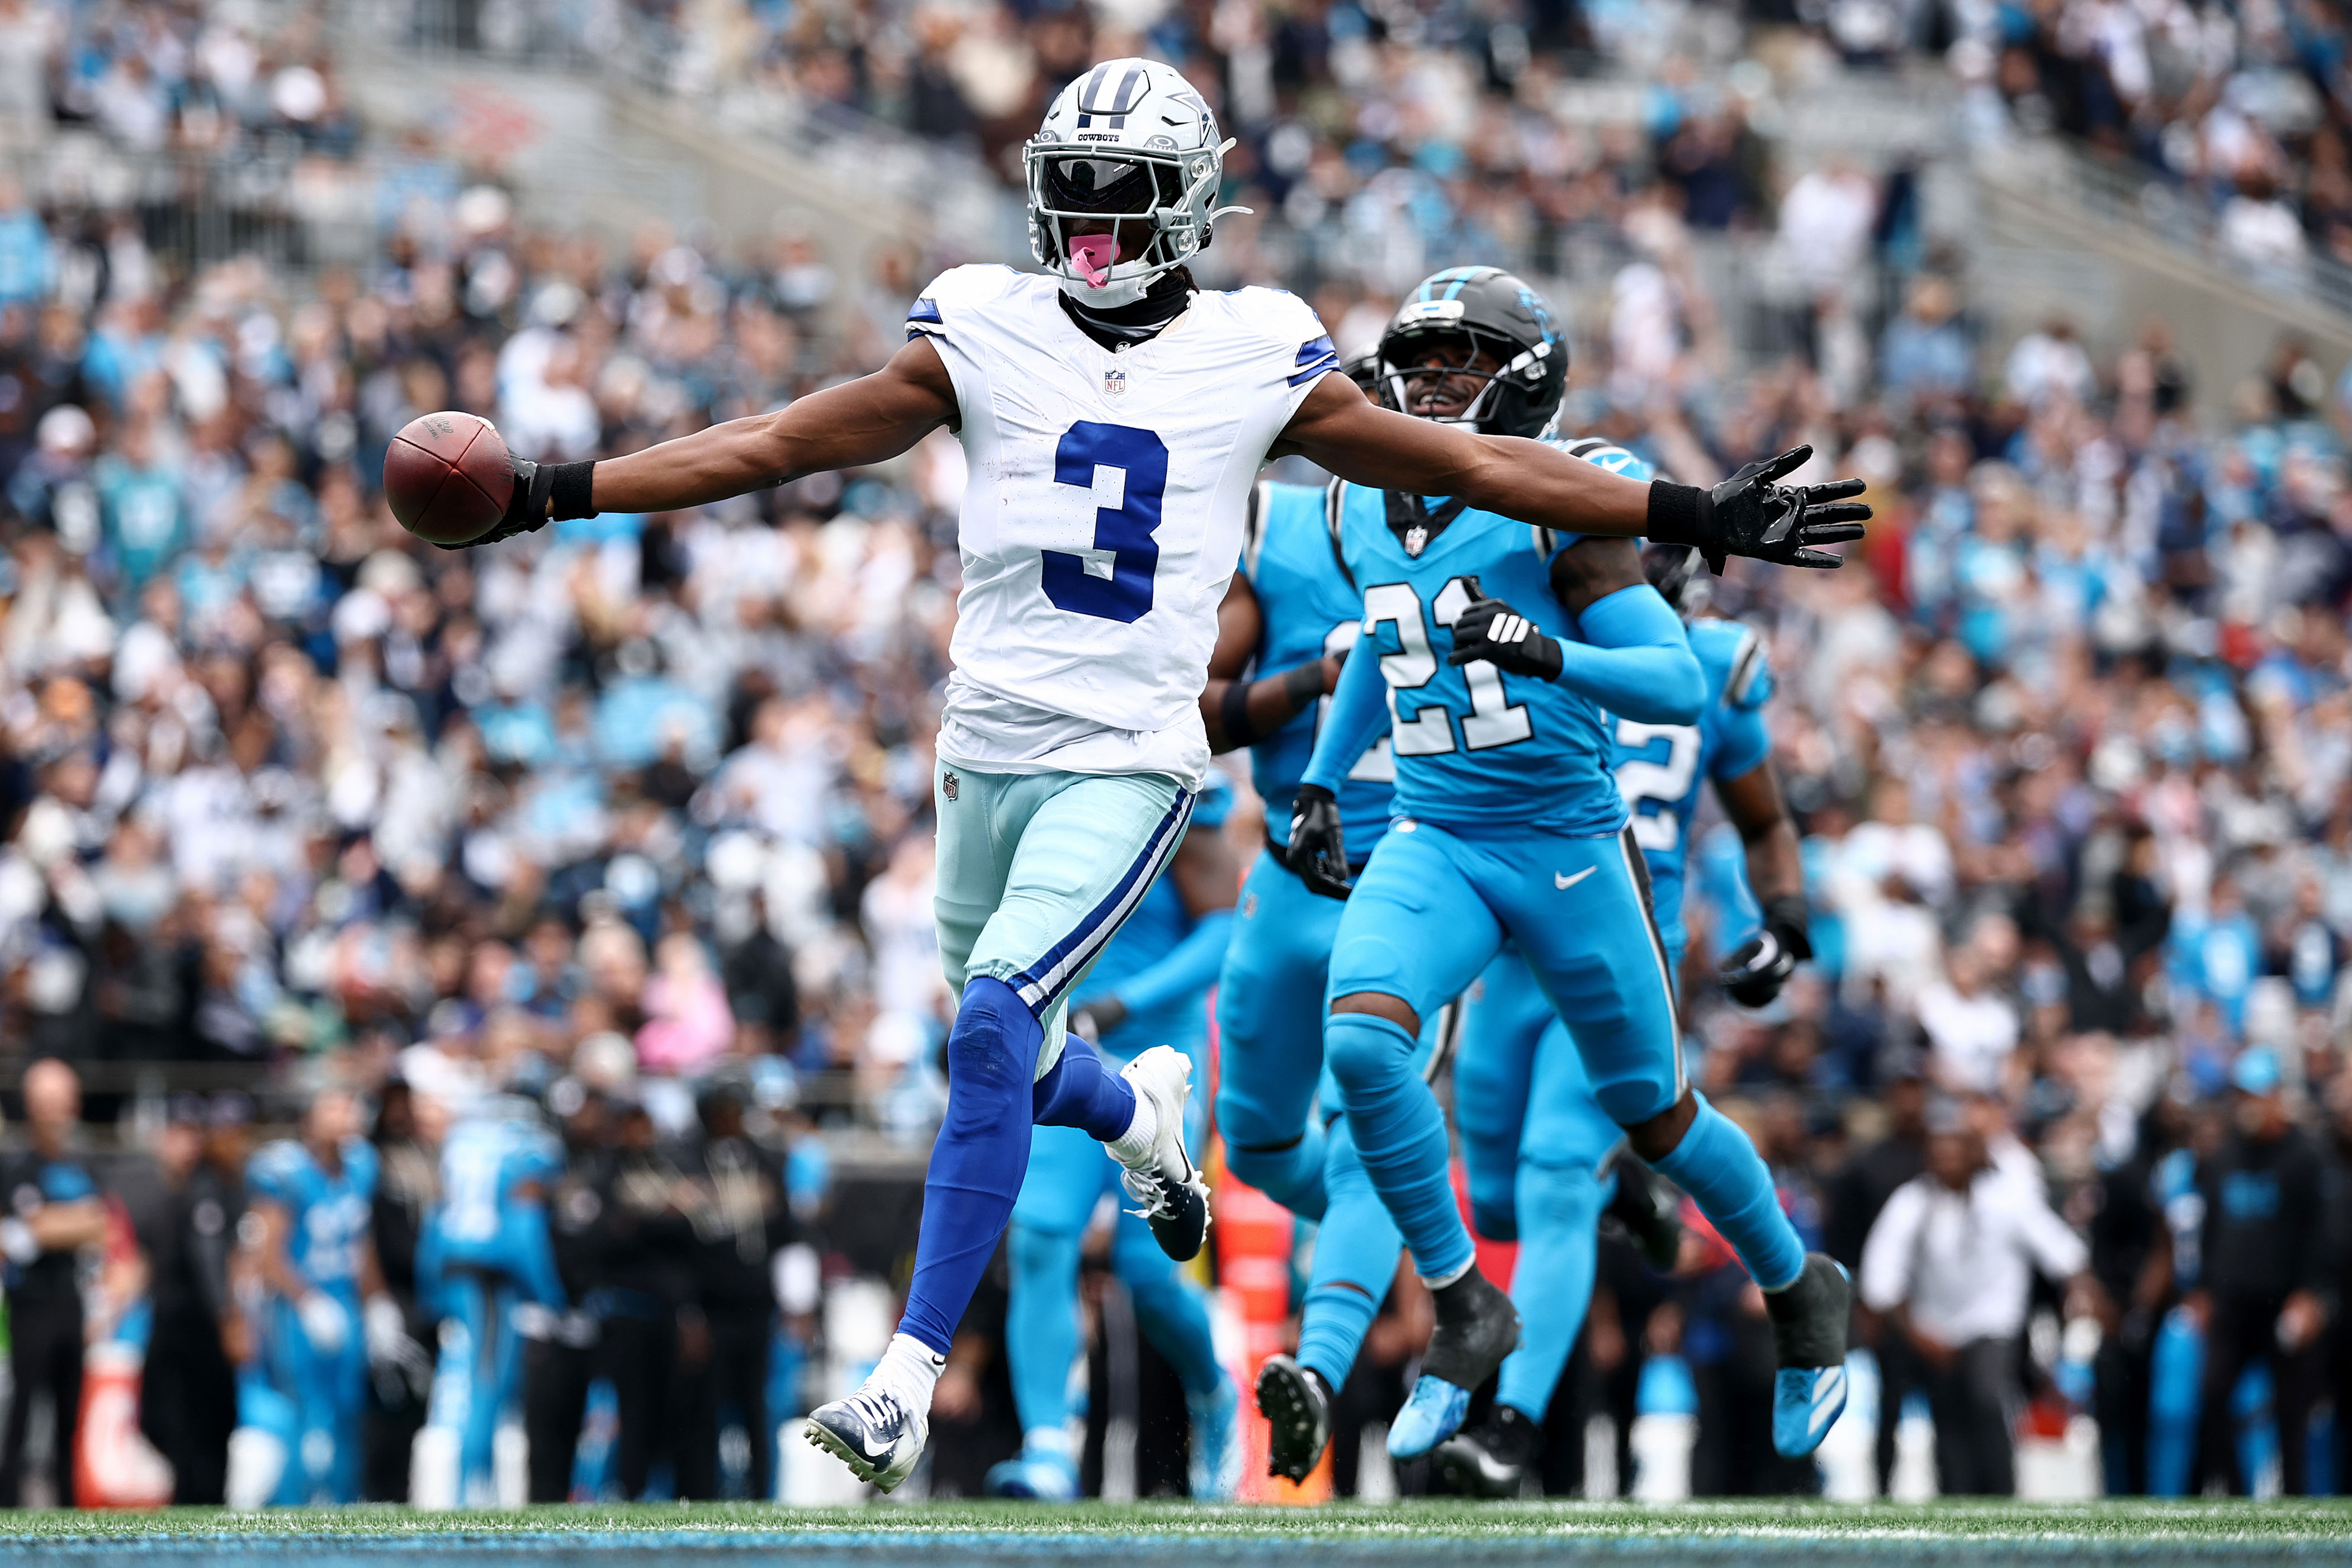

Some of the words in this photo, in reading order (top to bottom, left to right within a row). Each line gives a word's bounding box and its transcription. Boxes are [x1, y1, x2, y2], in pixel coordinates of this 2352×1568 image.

[1078, 134, 1120, 142] COWBOYS
[1107, 381, 1124, 391] NFL
[1040, 420, 1169, 624] 3
[1363, 575, 1534, 757] 21
[945, 783, 955, 795] NFL
